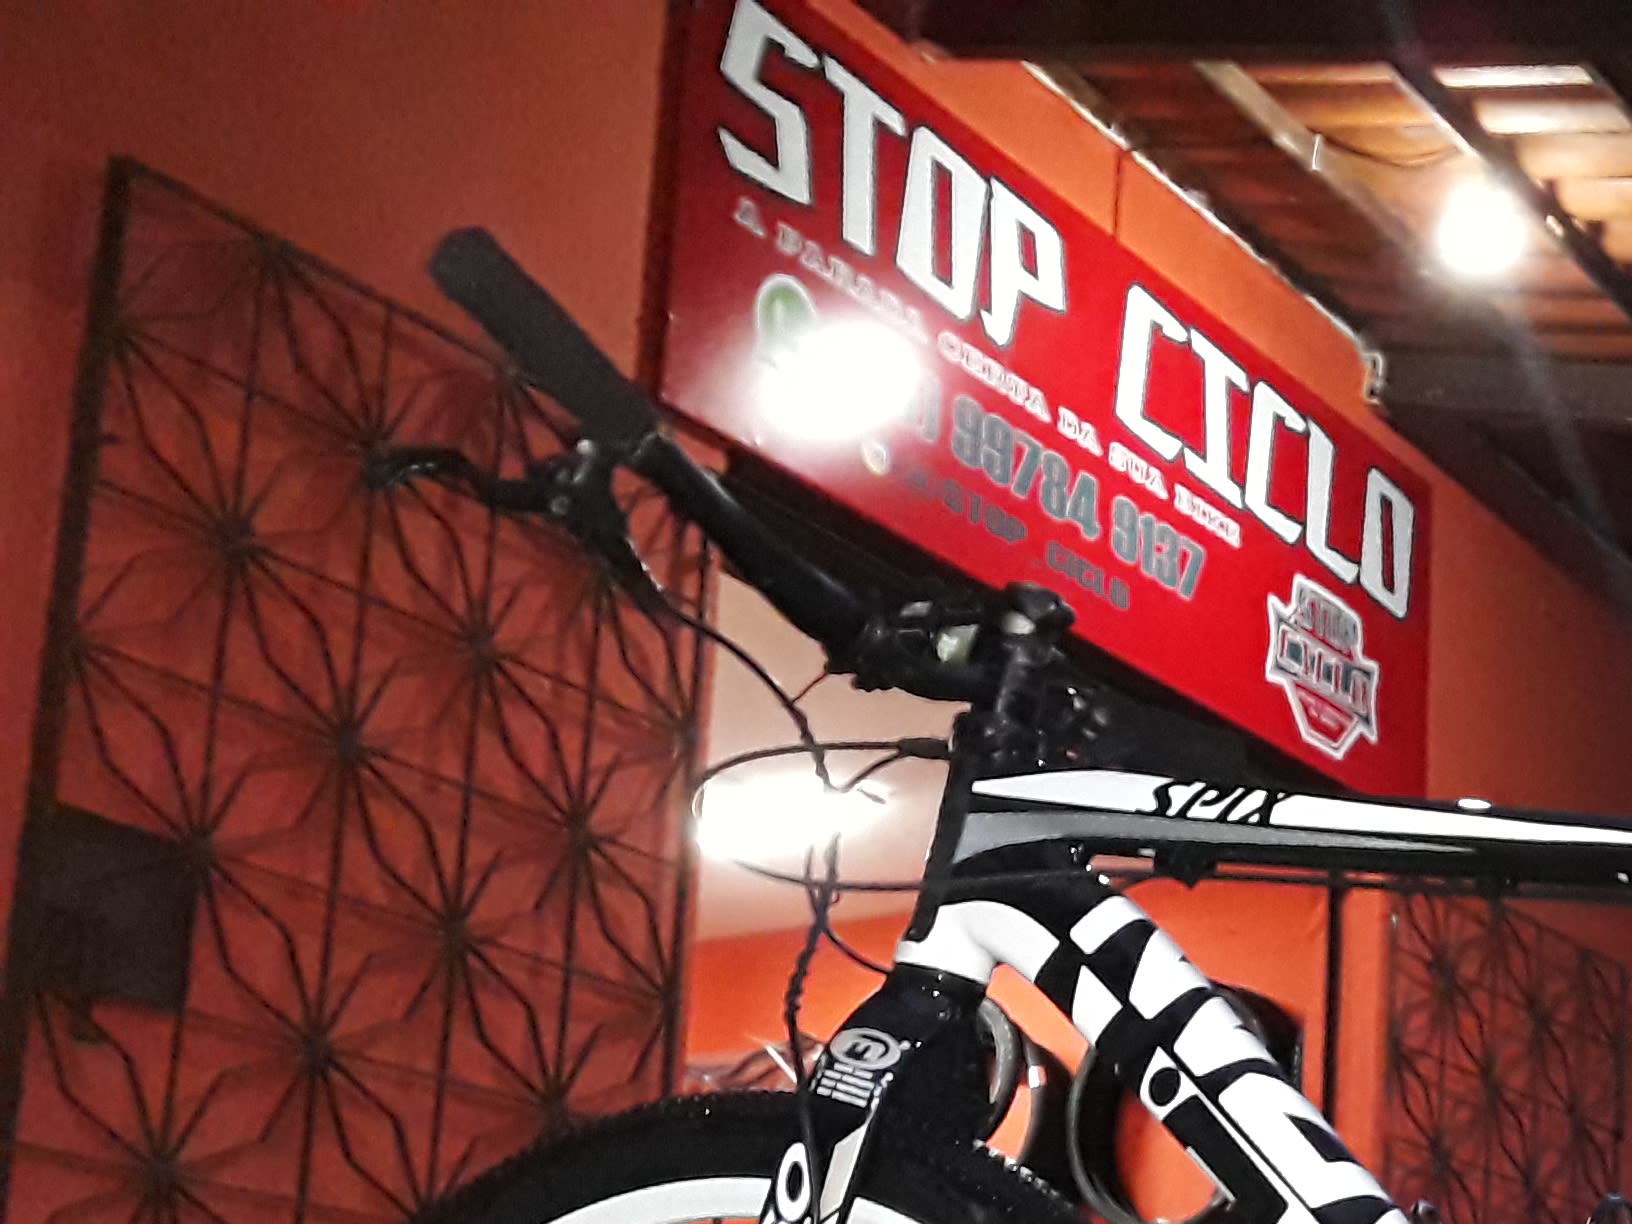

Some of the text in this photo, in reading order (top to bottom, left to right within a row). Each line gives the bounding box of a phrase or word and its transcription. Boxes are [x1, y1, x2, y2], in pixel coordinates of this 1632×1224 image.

[717, 0, 1415, 620] STOP CICLO
[937, 331, 1052, 423] CERTA
[1057, 405, 1103, 457] DA
[1108, 441, 1169, 500] SUA
[952, 393, 1101, 541] 99784
[1110, 494, 1207, 602] 9137
